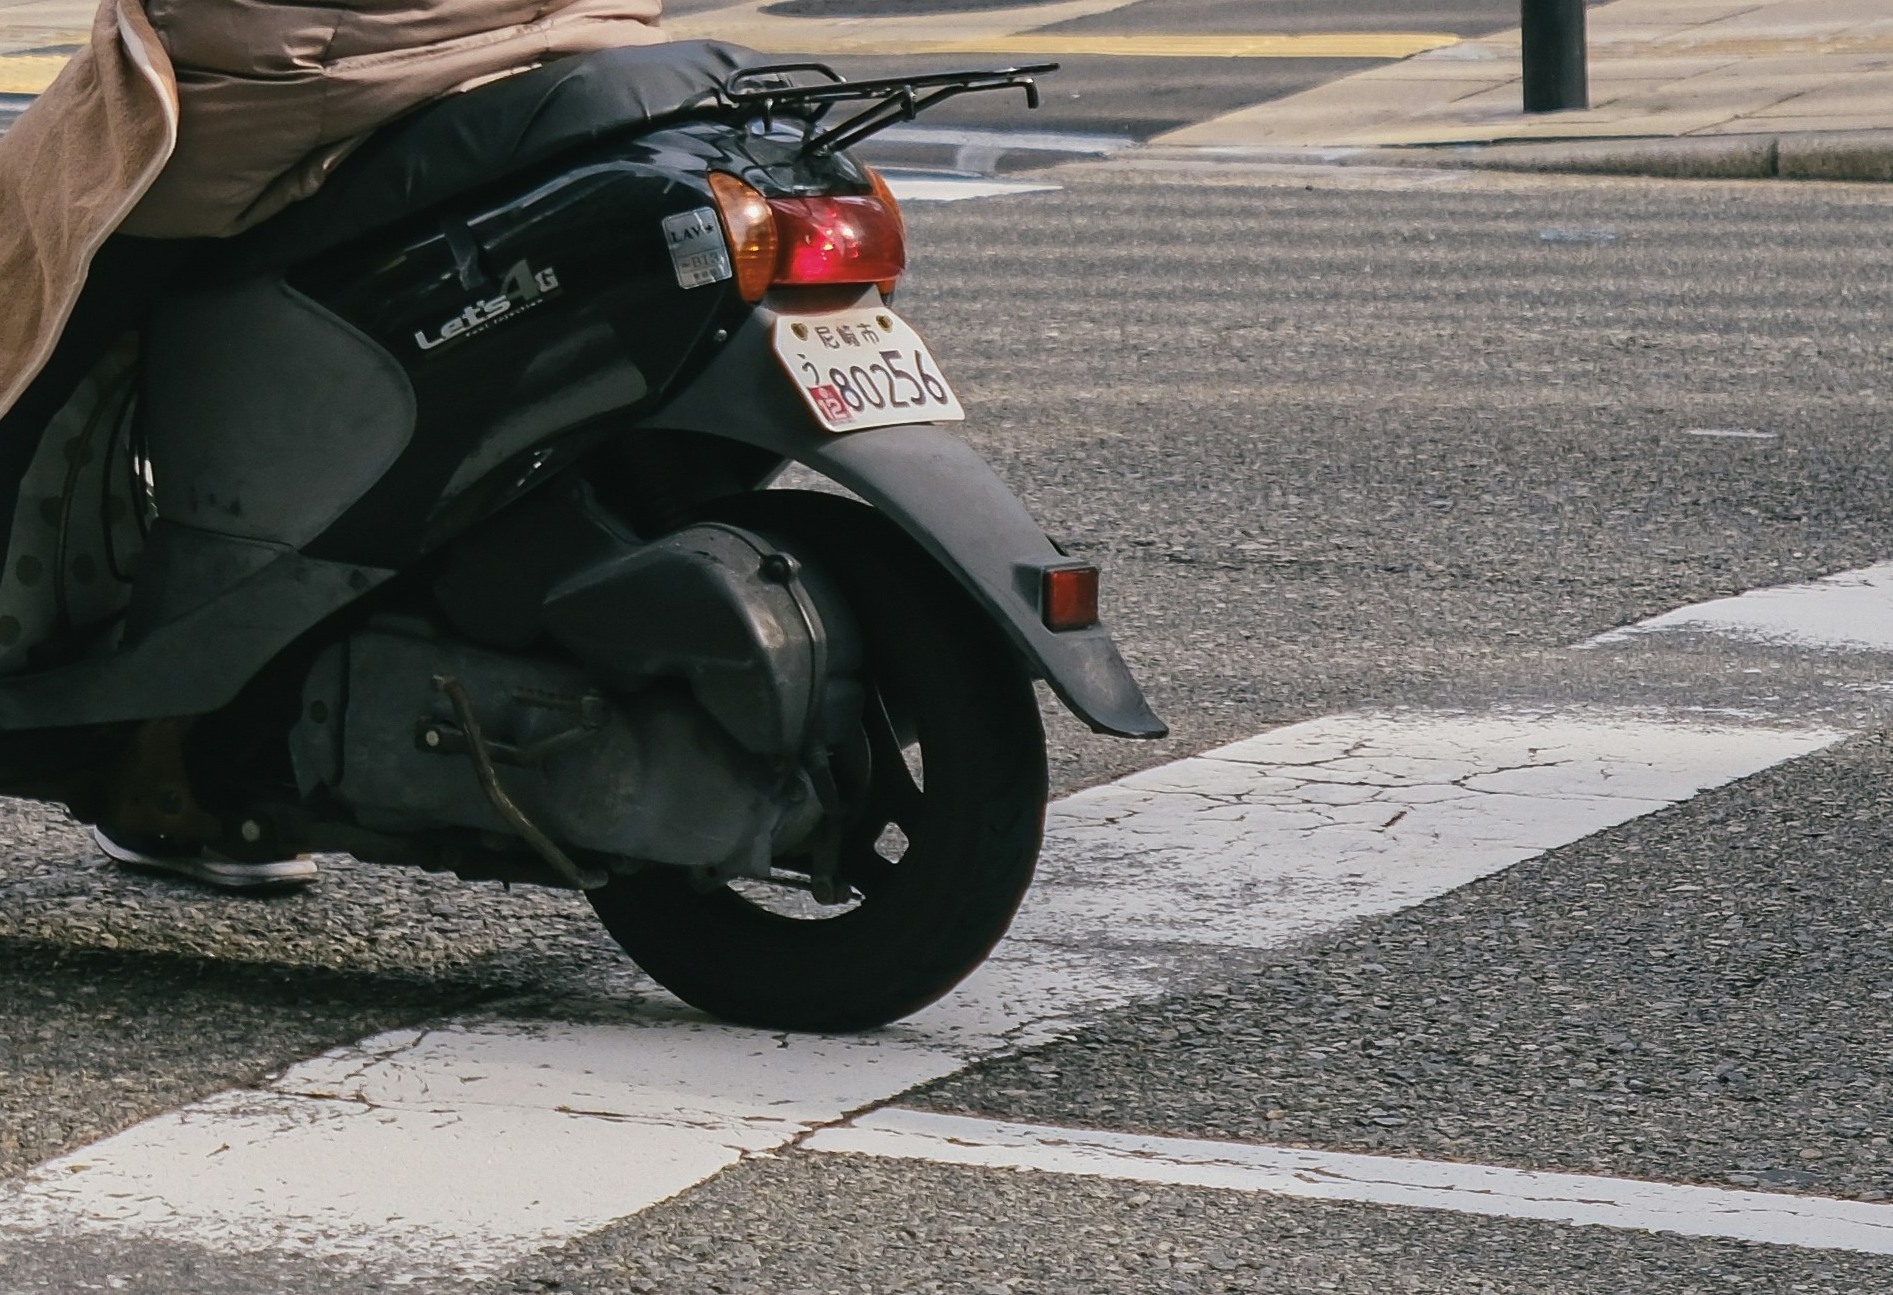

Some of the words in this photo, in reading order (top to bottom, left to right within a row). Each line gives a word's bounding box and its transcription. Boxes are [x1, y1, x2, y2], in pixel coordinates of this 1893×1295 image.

[816, 322, 879, 349] 尼崎市
[829, 350, 948, 412] 80256
